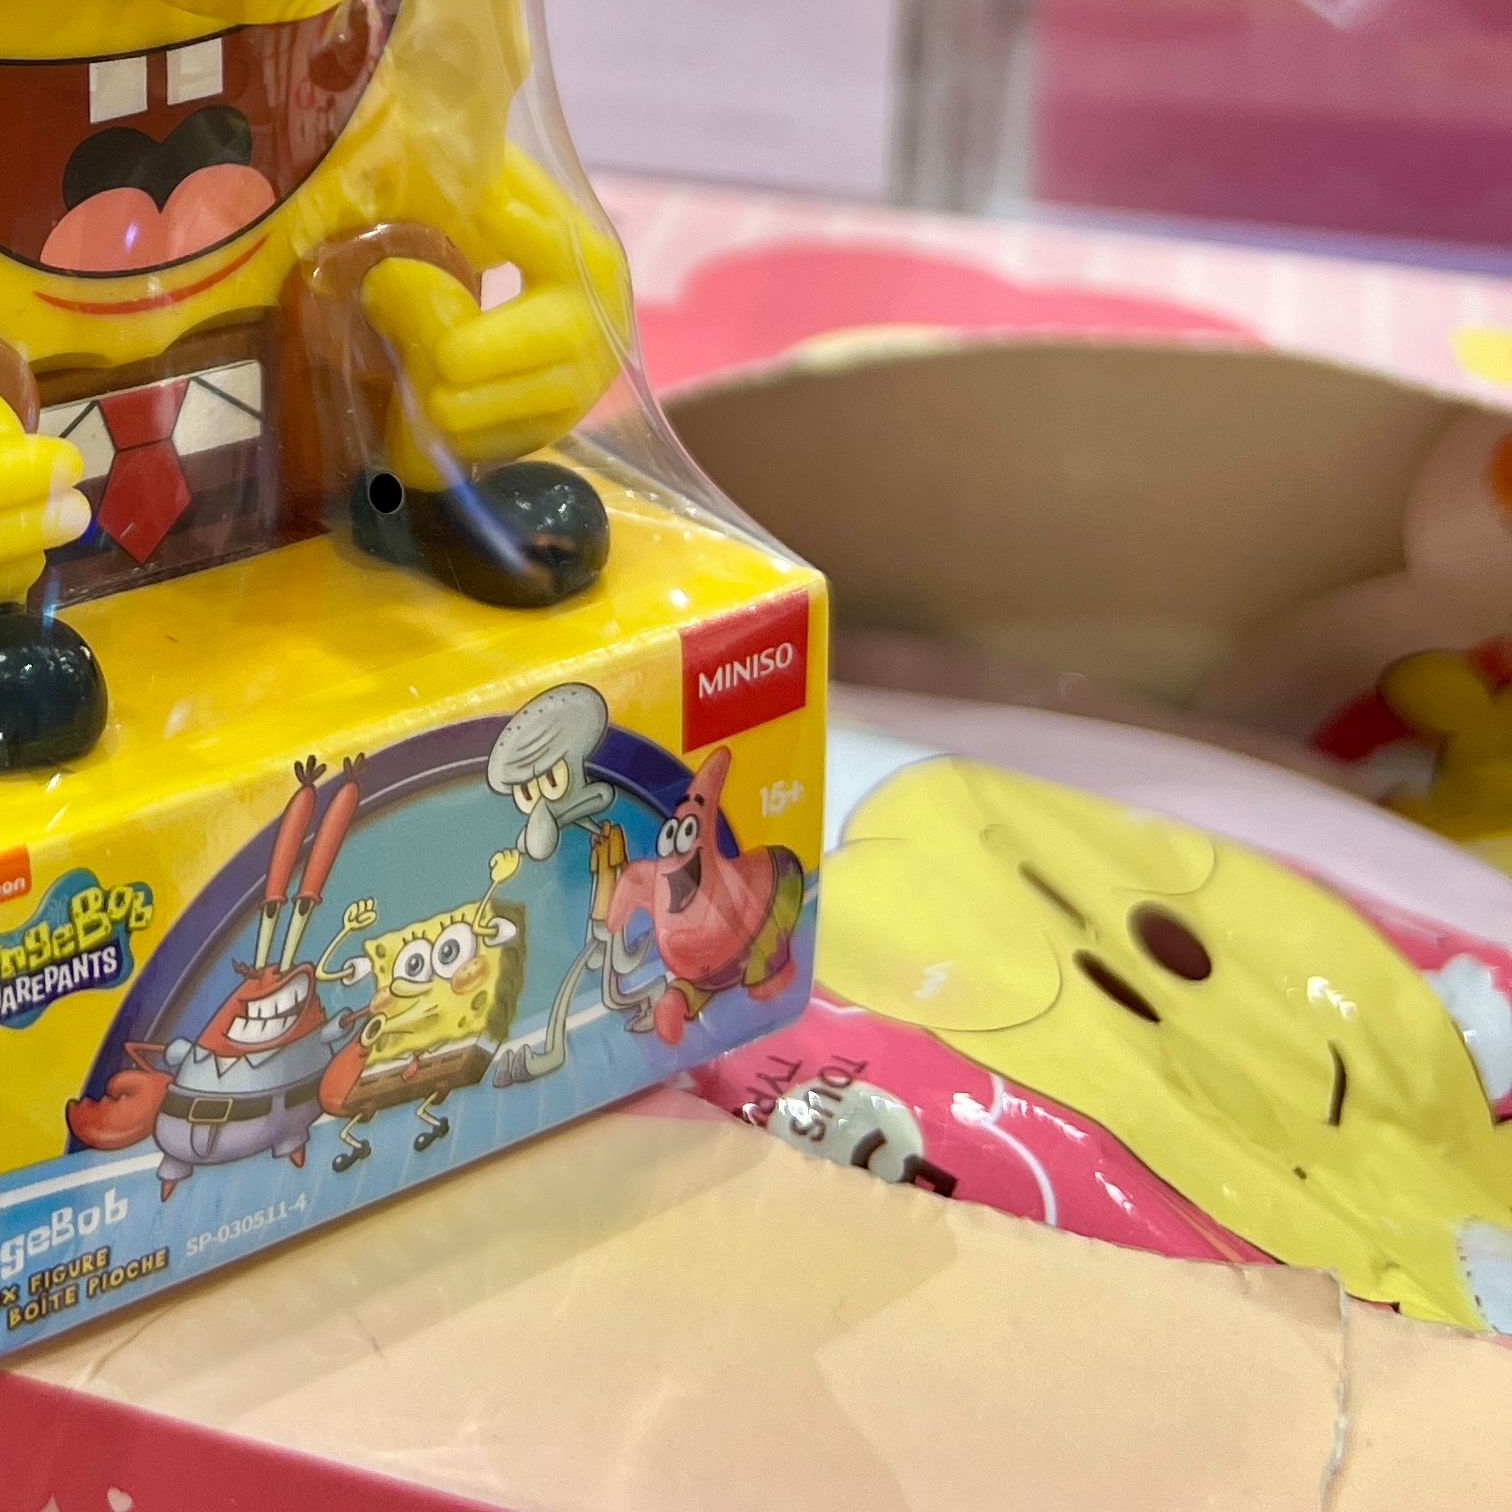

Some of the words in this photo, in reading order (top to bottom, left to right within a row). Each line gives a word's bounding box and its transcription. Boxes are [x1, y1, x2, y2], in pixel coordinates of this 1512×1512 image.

[698, 642, 794, 700] MINISO
[186, 1192, 307, 1257] SP-030511-4
[29, 1245, 111, 1296] FIGURE
[86, 1247, 170, 1299] PIOCHE
